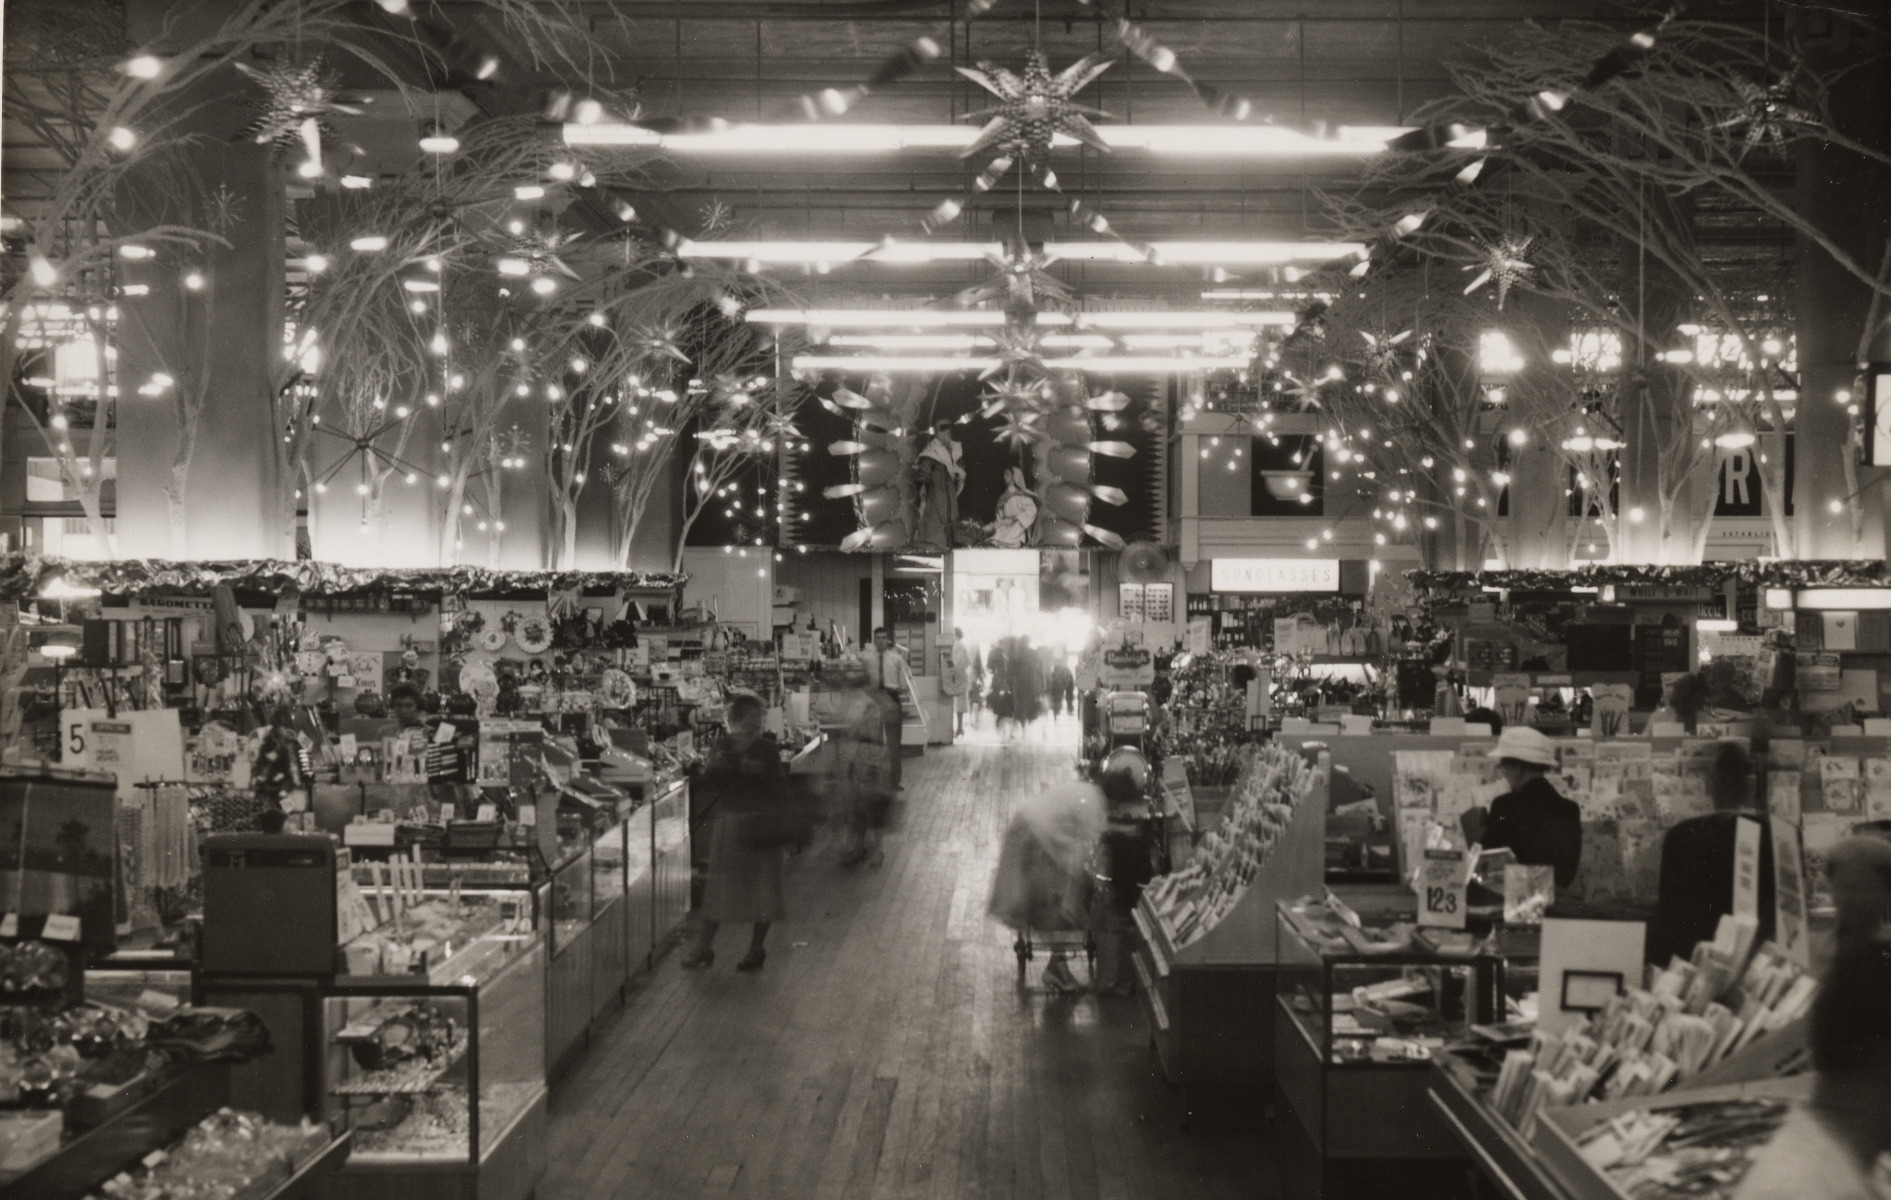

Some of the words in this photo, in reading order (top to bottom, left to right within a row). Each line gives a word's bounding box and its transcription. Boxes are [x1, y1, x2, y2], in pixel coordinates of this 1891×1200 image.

[1725, 446, 1750, 504] R
[1222, 568, 1331, 582] SUNGLASSES
[70, 724, 84, 754] 5
